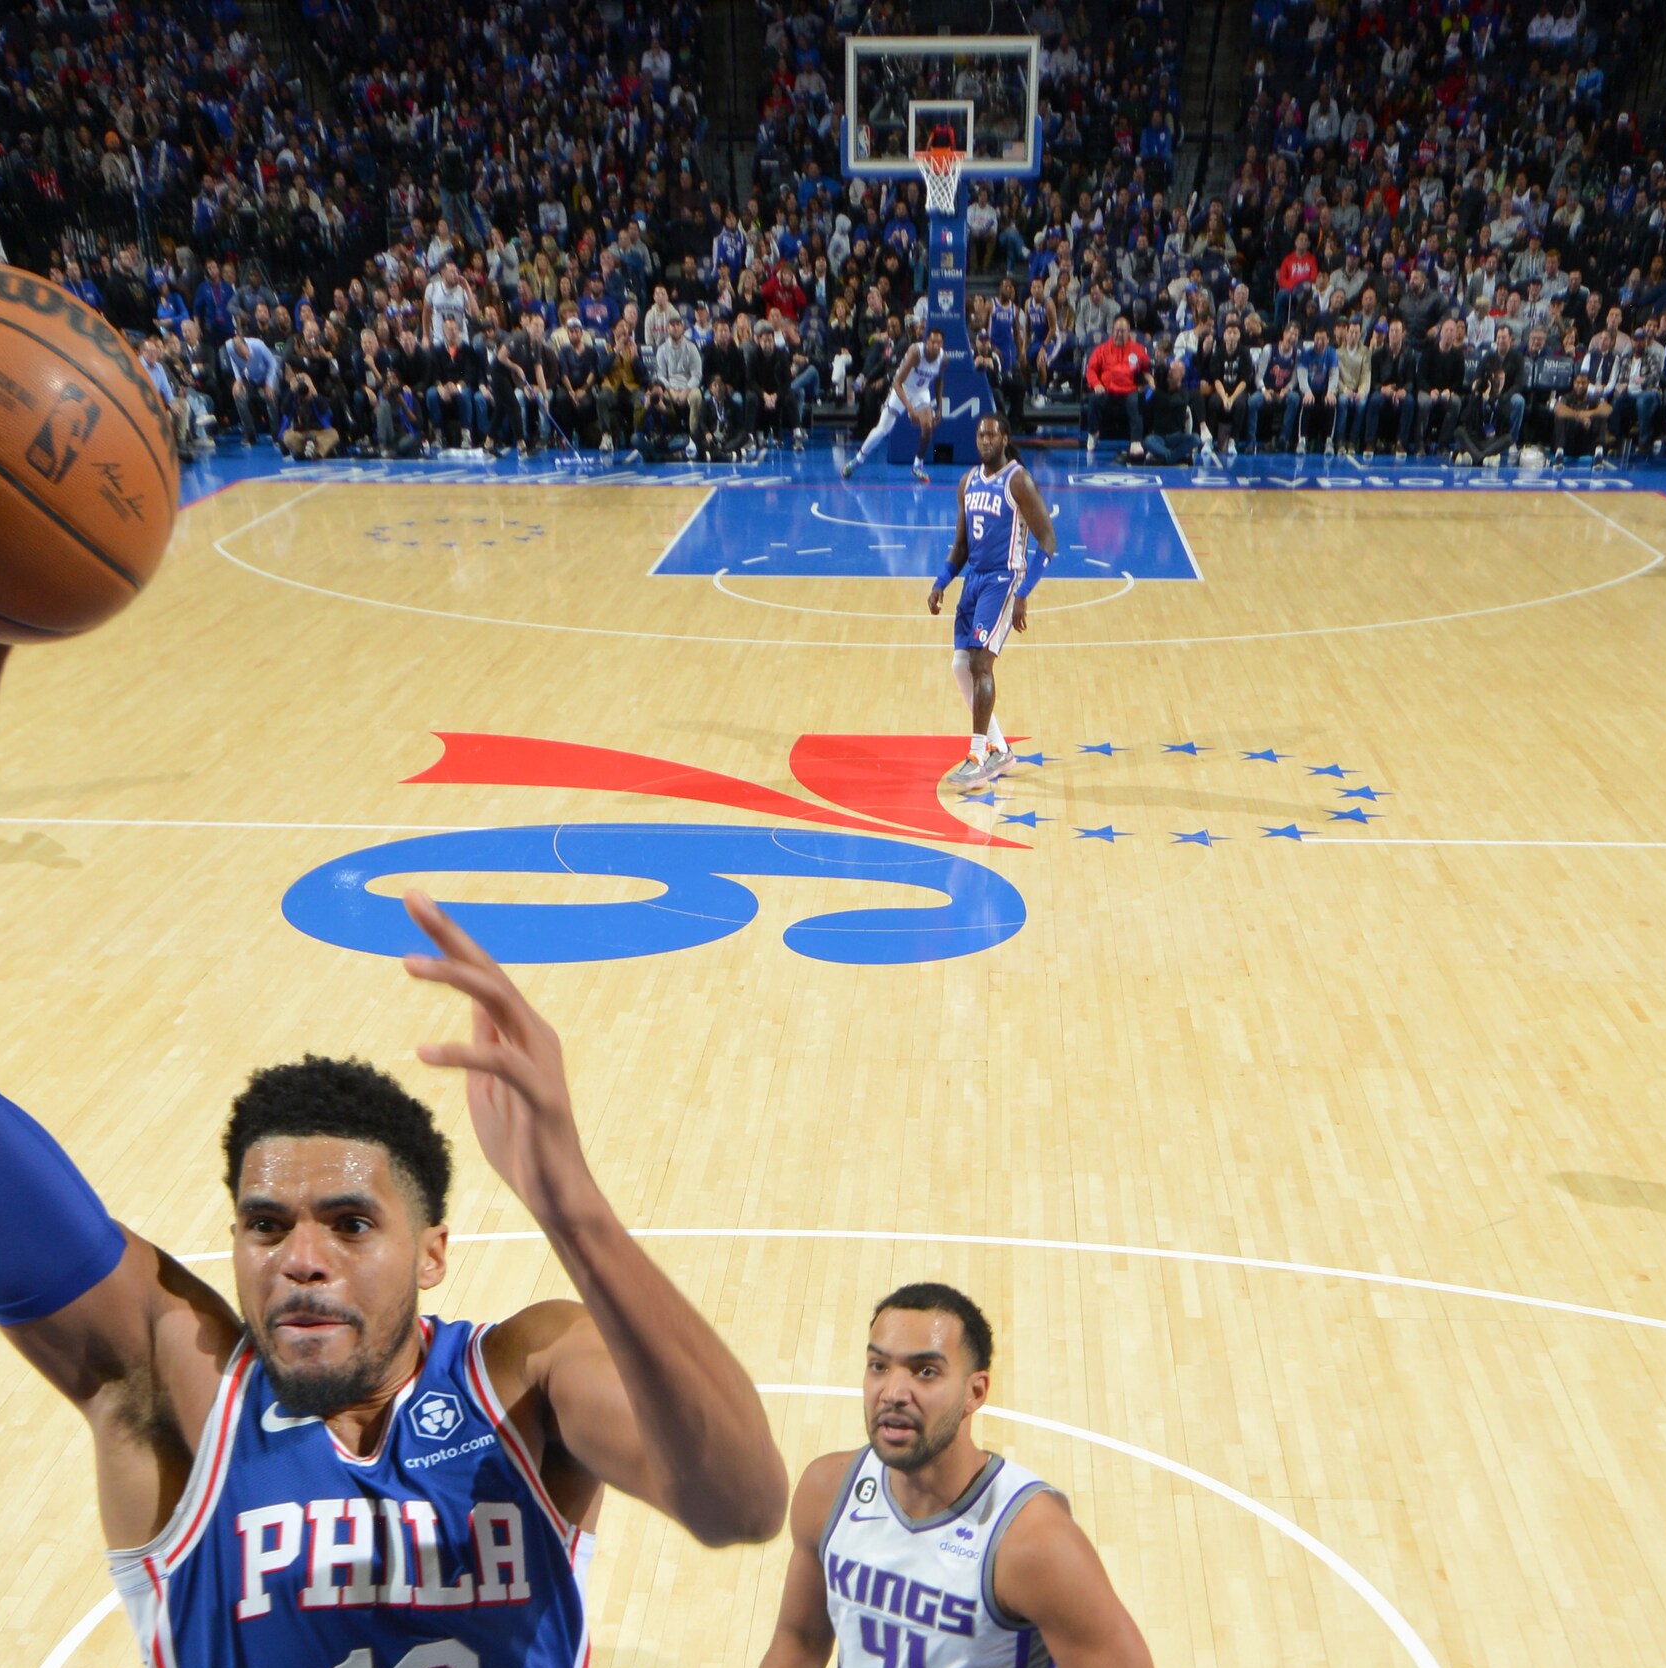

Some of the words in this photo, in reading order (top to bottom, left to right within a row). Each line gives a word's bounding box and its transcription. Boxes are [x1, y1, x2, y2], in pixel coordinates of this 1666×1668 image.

[1191, 476, 1633, 489] crypto.com
[964, 489, 1002, 517] PHILA
[973, 515, 984, 541] 5
[404, 1433, 496, 1471] crypto.com
[859, 1478, 876, 1502] 6
[237, 1499, 532, 1623] PHILA
[828, 1552, 977, 1638] KINGS
